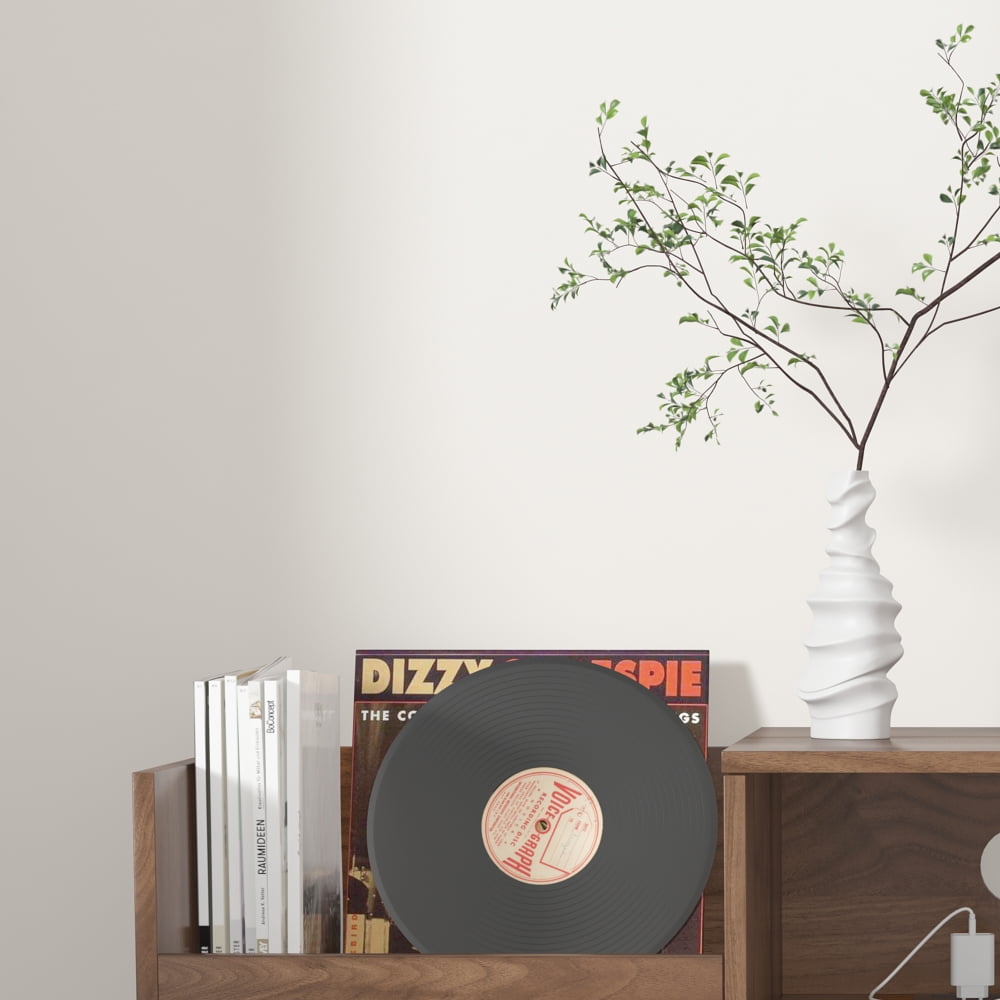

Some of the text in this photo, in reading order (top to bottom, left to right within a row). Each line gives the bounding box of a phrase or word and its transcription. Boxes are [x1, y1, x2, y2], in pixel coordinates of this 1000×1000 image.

[266, 700, 276, 734] BoConcept
[361, 710, 389, 721] THE
[545, 781, 583, 820] VOICE
[256, 819, 267, 875] RAUMIDEEN
[502, 833, 541, 877] GRAPH
